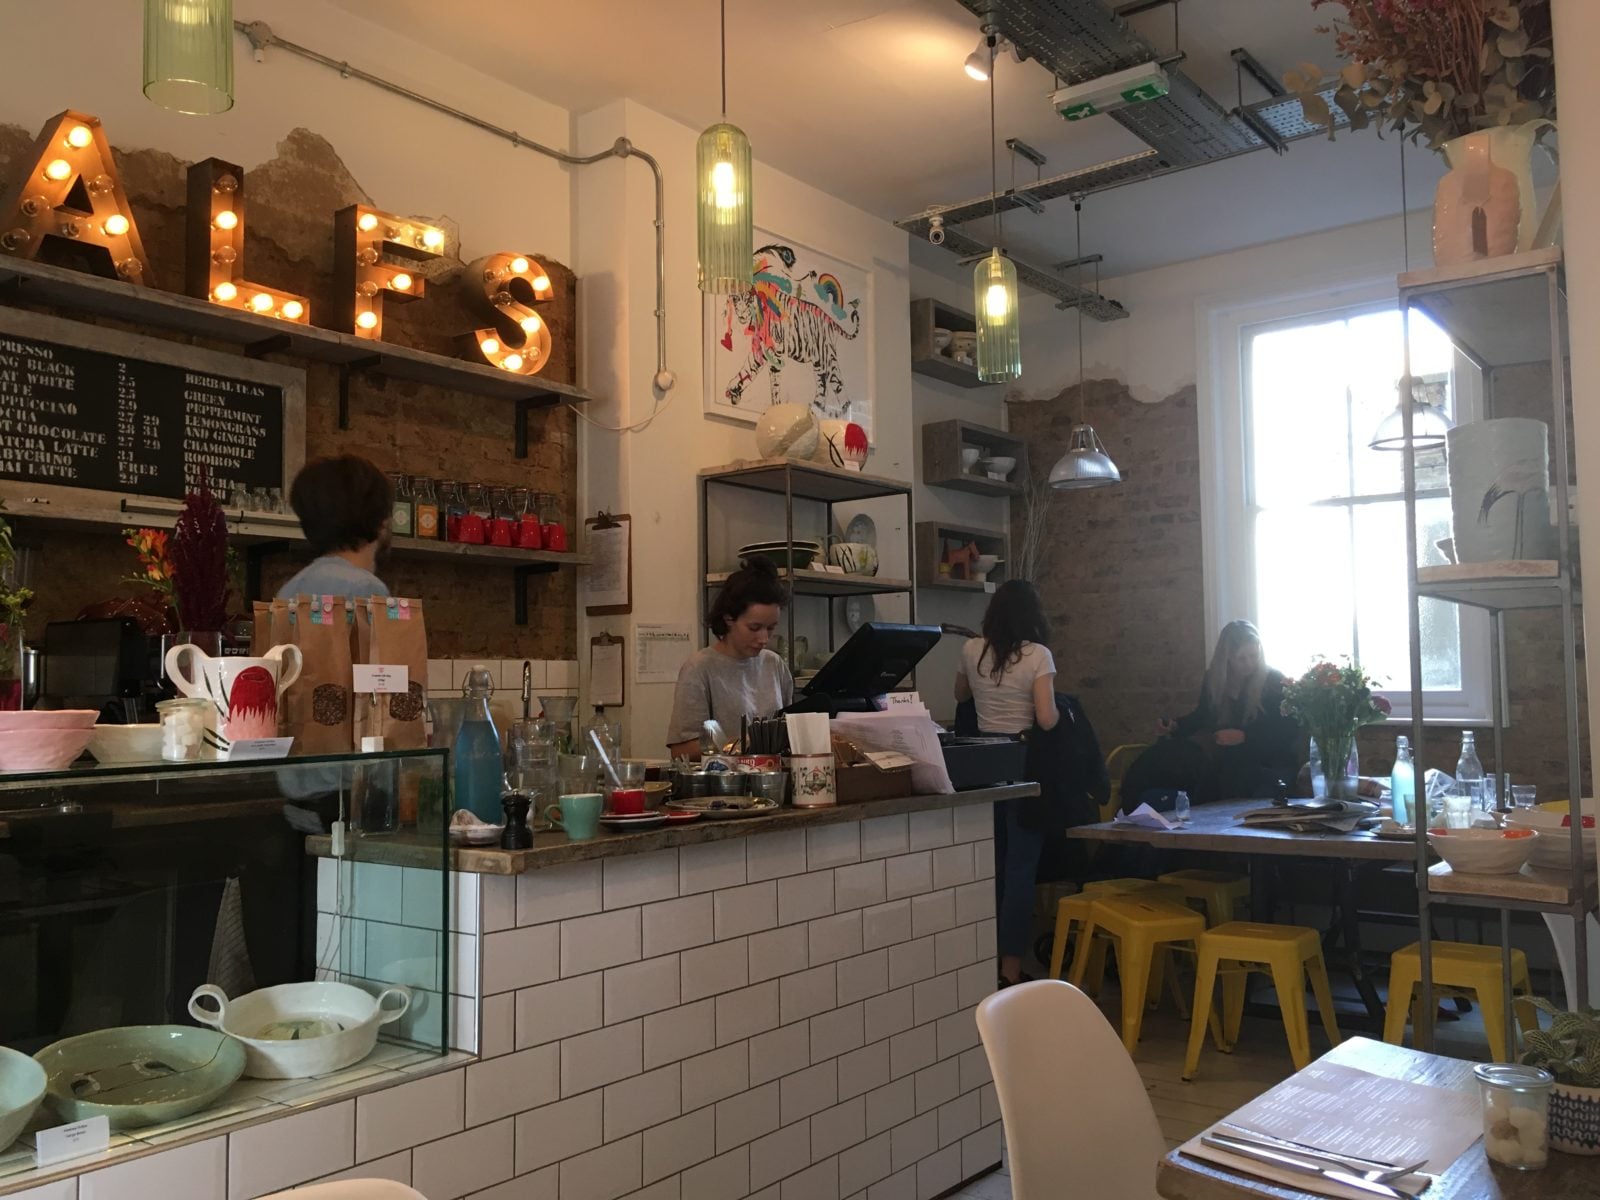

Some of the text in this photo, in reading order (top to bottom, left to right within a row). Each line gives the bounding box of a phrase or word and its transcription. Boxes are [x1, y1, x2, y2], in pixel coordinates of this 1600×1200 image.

[27, 359, 75, 376] BLACK
[118, 362, 126, 373] 2
[27, 373, 75, 391] WHITE
[184, 390, 226, 406] GREEN
[186, 402, 262, 424] PEPPERMINT
[17, 422, 107, 445] CHOCOLATE
[185, 414, 267, 438] LEMONGRASS
[184, 427, 257, 447] AND GINGER
[54, 440, 99, 458] LATTE
[183, 439, 255, 460] CHAMOMILE
[0, 448, 158, 476] BYCHINO FREE
[184, 451, 241, 468] ROOIBOS
[29, 463, 78, 479] LATTE
[185, 484, 226, 500] FRSH
